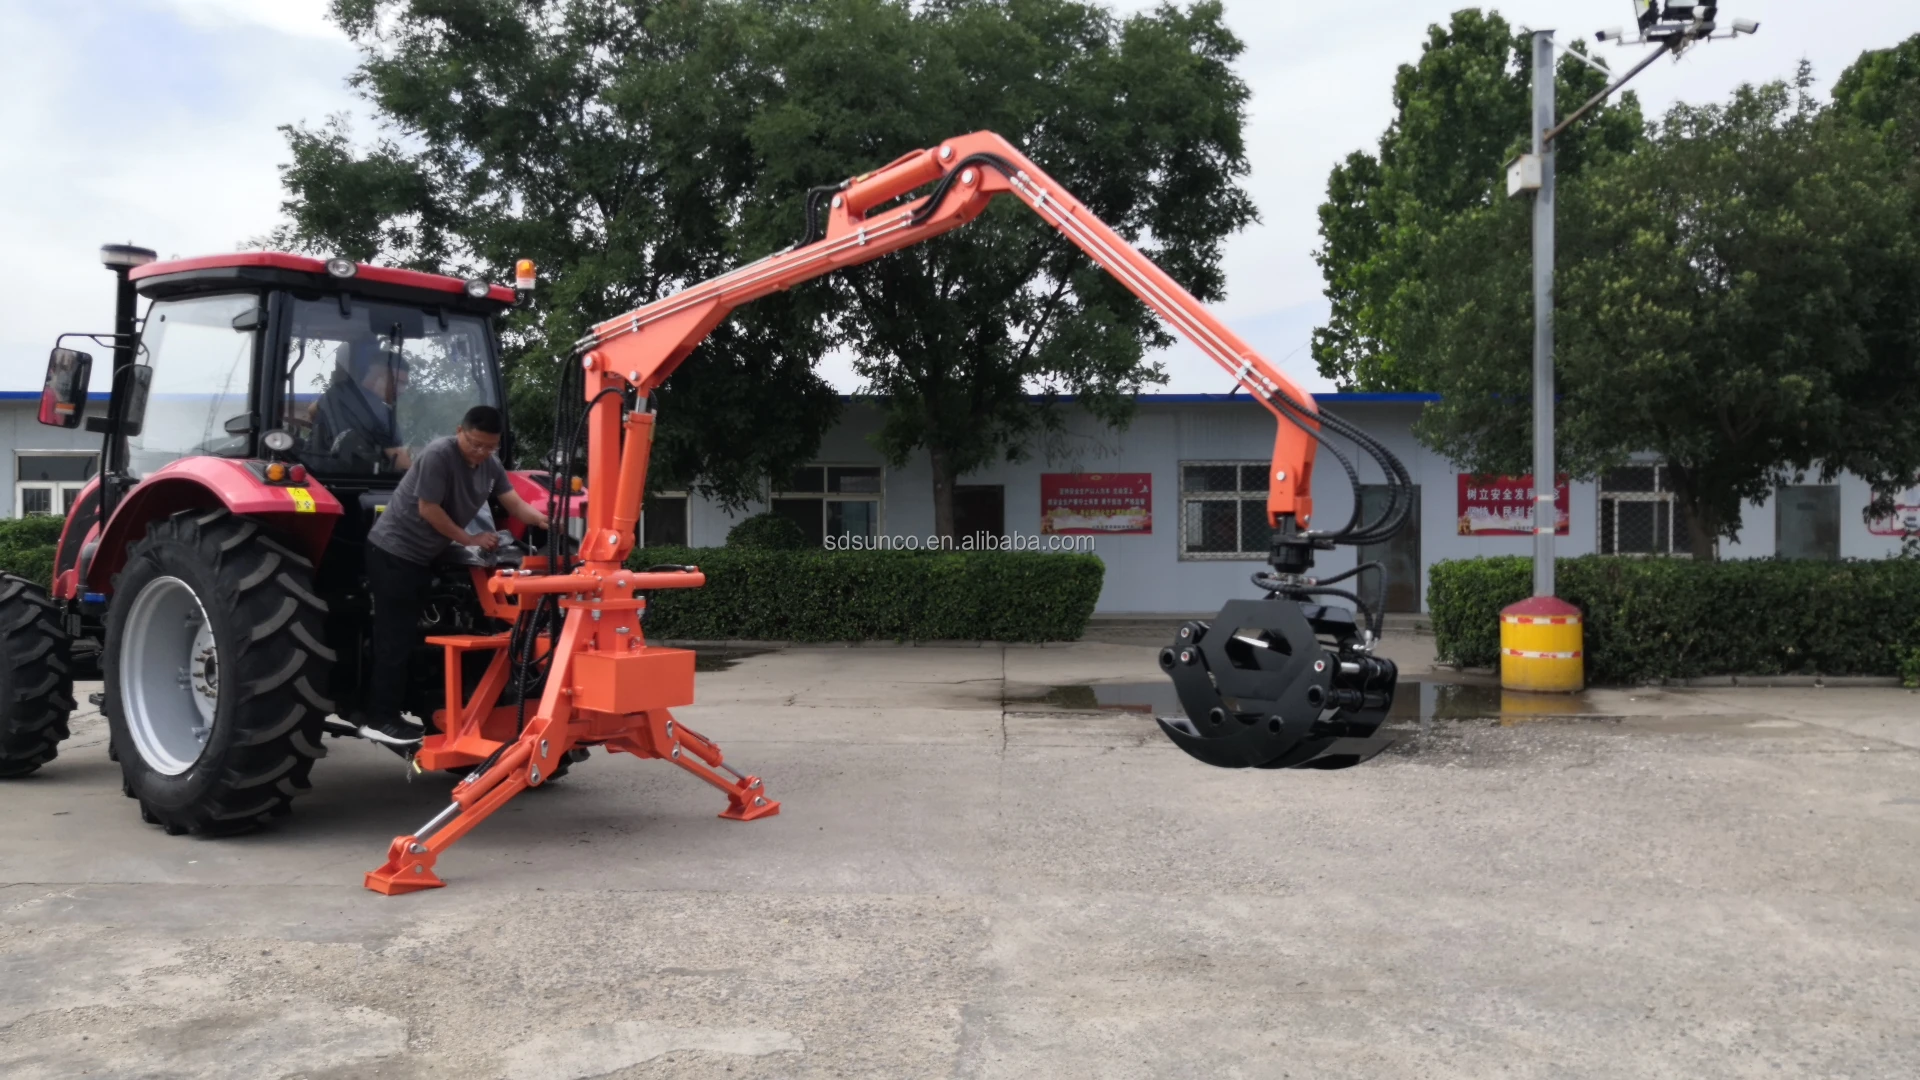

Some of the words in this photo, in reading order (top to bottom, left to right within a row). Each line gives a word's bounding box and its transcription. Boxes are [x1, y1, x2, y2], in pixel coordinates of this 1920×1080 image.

[1467, 488, 1560, 500] 树立安全发展念
